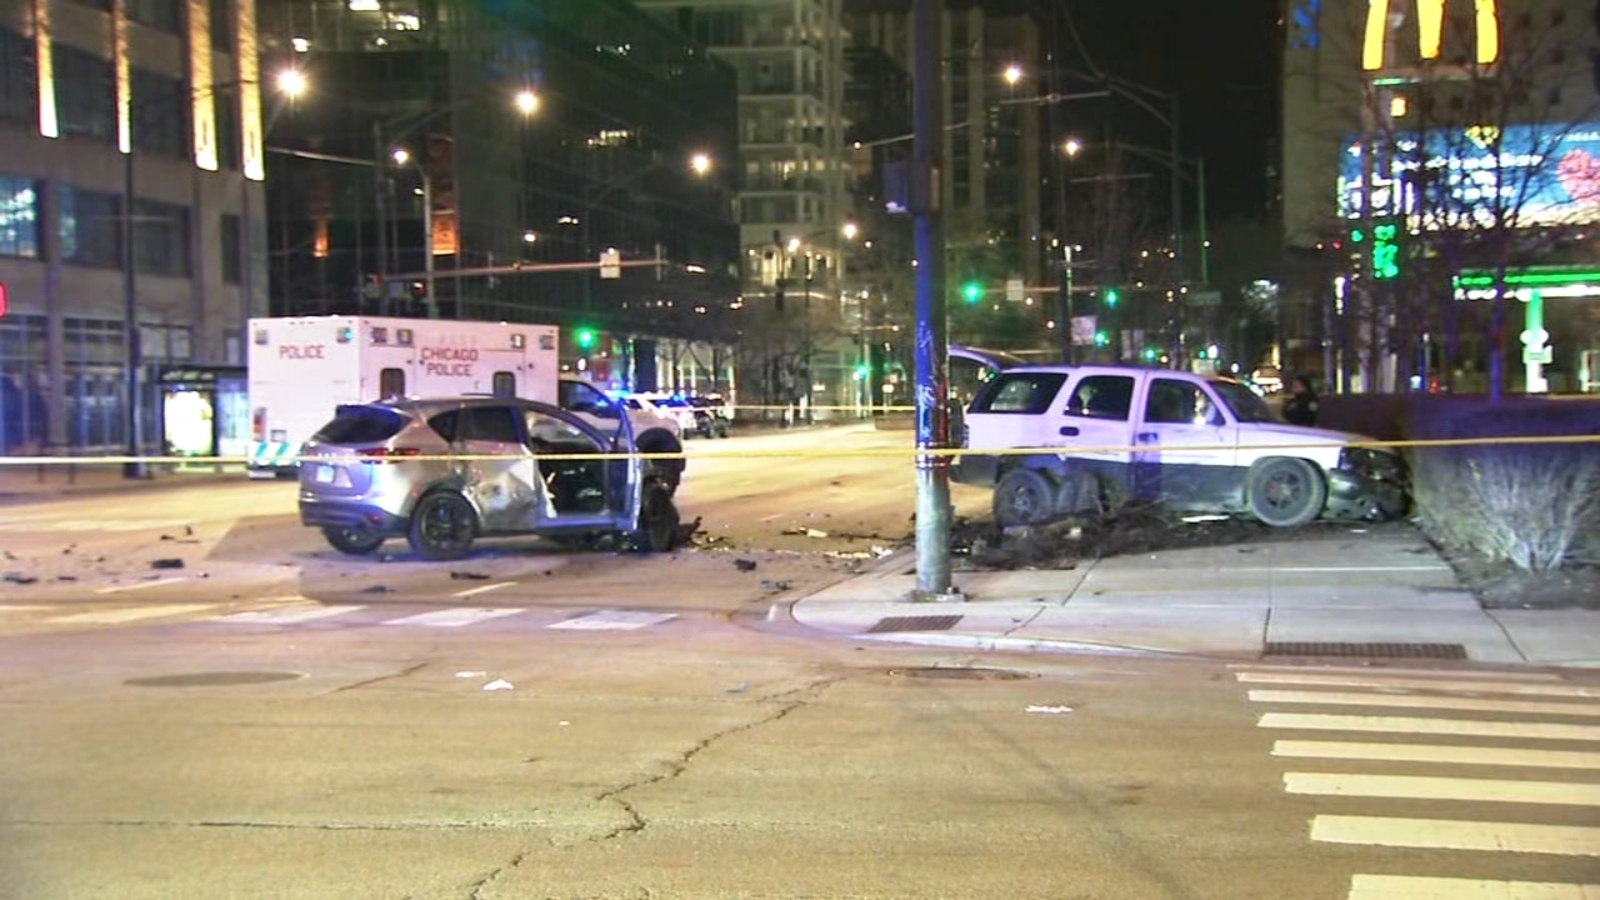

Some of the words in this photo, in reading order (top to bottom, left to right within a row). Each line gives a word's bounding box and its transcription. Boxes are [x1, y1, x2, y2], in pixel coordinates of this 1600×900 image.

[280, 345, 323, 360] POLICE
[421, 347, 478, 361] CHICAGO
[427, 362, 473, 377] POLICE
